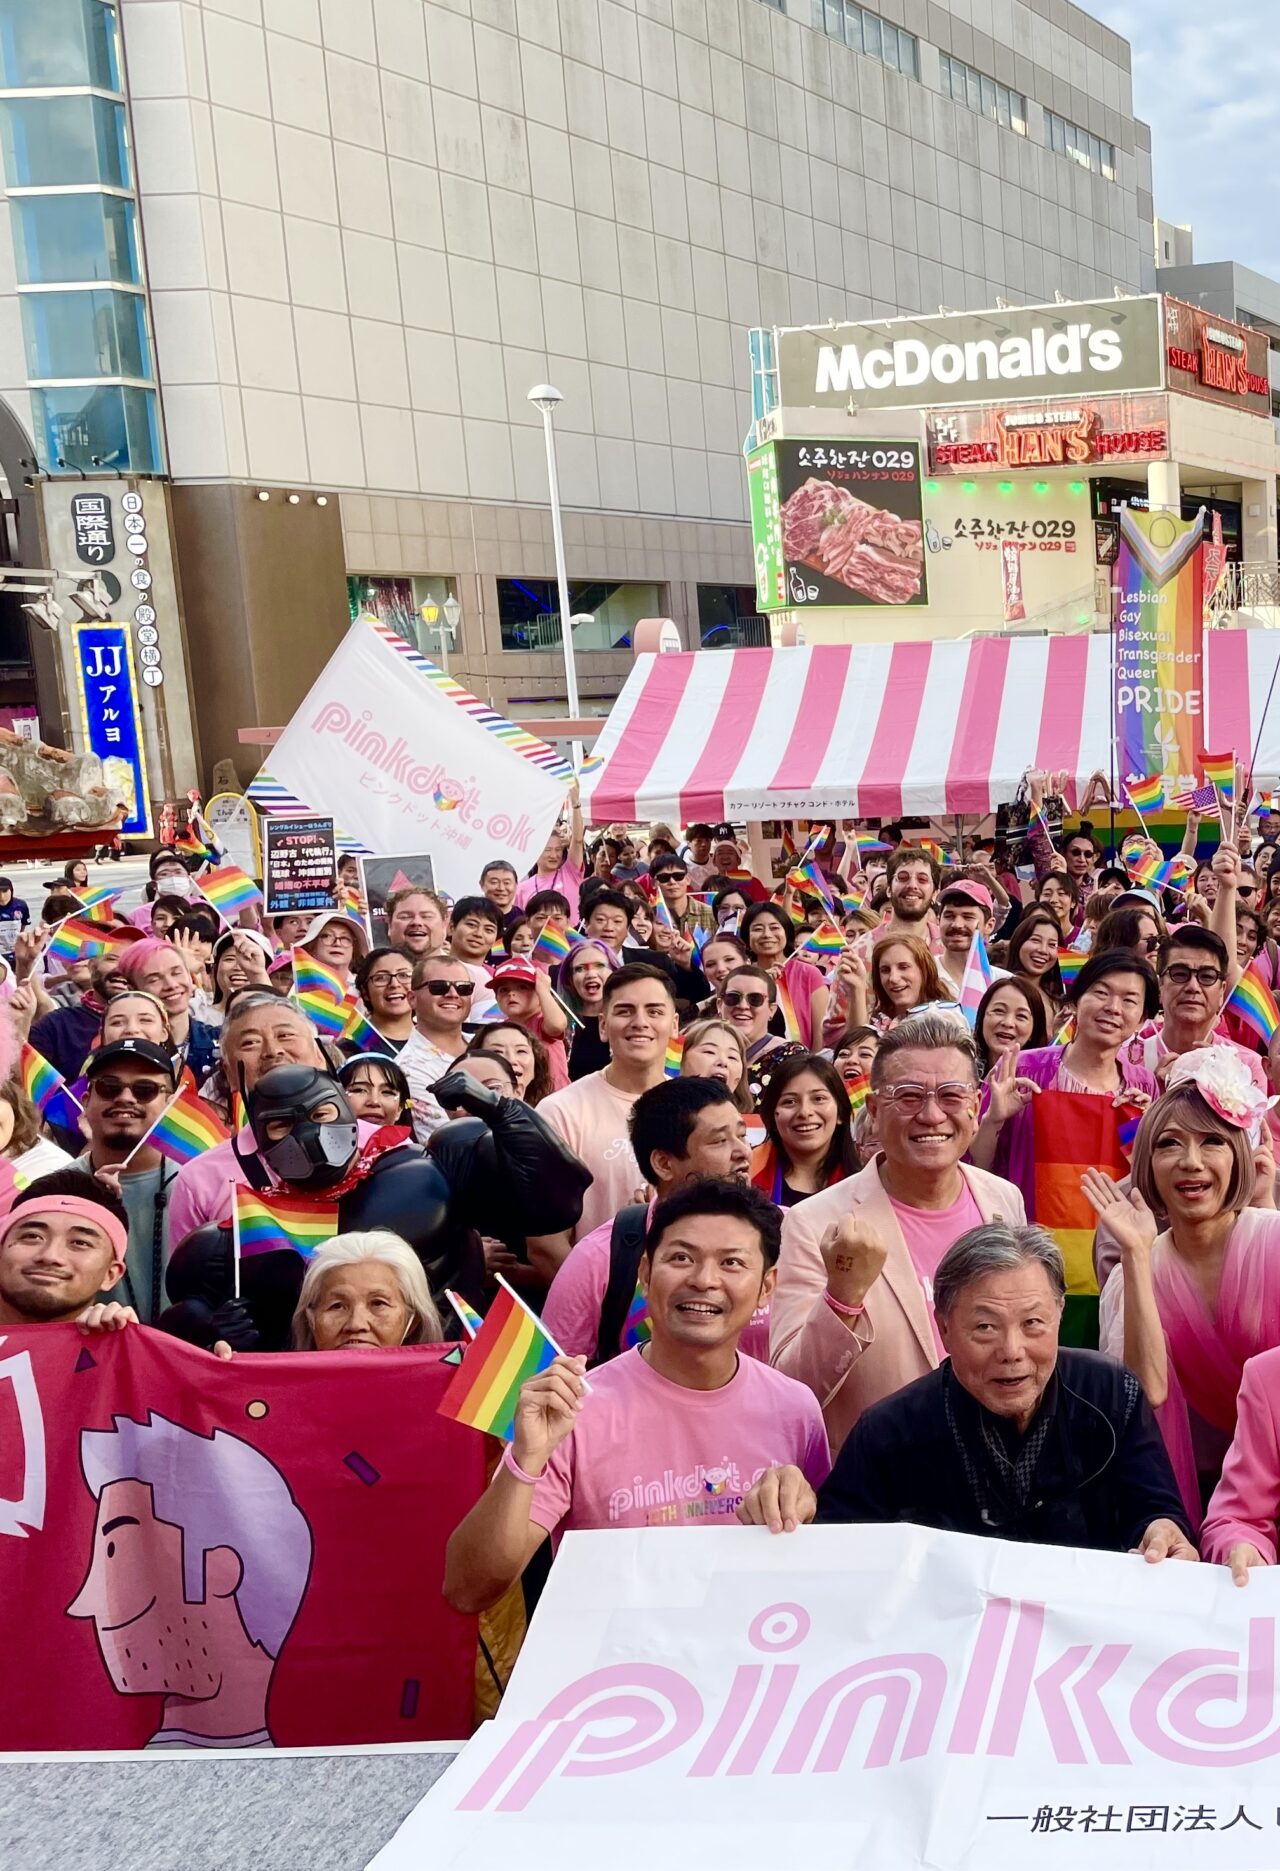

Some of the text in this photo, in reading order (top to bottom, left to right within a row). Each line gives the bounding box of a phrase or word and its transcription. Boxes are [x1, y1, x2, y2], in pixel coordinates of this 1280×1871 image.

[815, 324, 1123, 393] McDonald's
[936, 442, 998, 464] STEAK
[1095, 430, 1168, 454] HOUSE
[872, 450, 915, 469] 029
[75, 498, 112, 561] 国際通り
[1032, 520, 1076, 539] 029
[1121, 590, 1168, 604] Lesbian
[1119, 610, 1141, 625] Gay
[1119, 630, 1170, 642] Bisexual
[86, 646, 123, 677] JJ
[1118, 649, 1201, 664] Transgender
[1117, 666, 1158, 680] Queer
[1117, 686, 1201, 715] PRIDE
[285, 835, 317, 846] STOP!
[373, 907, 388, 916] SIL
